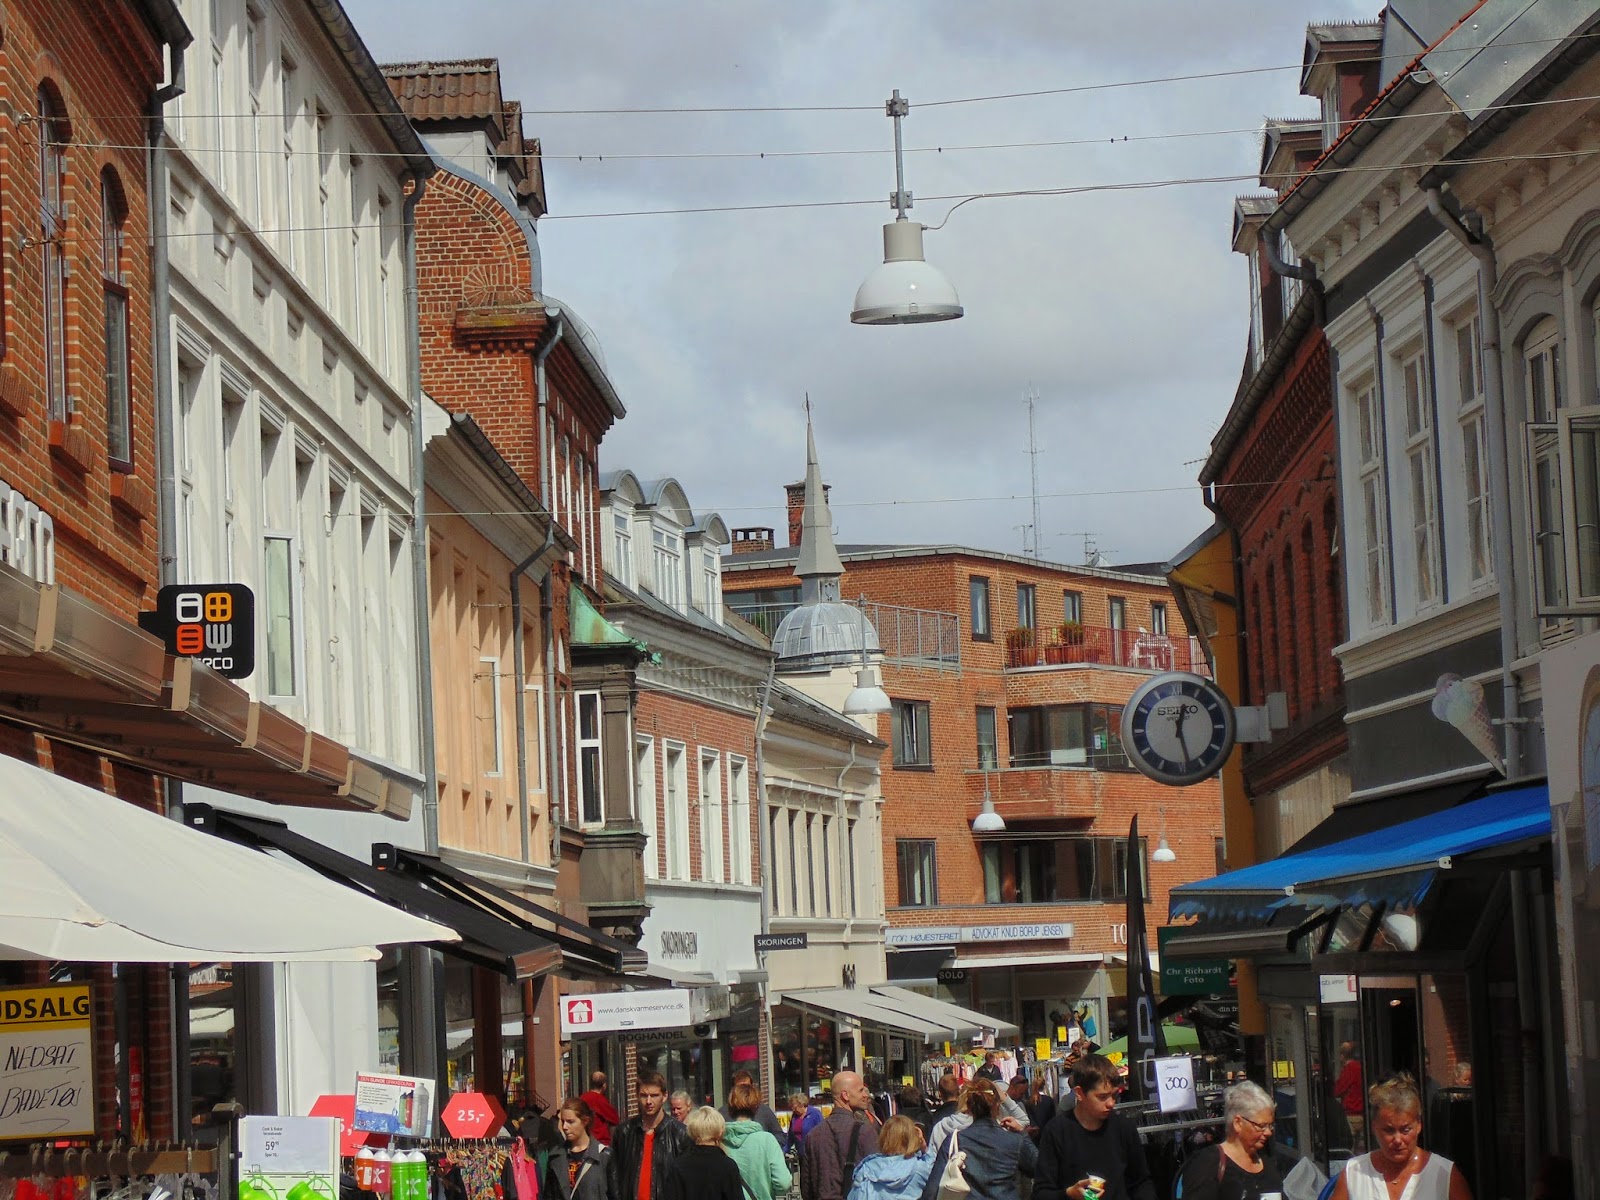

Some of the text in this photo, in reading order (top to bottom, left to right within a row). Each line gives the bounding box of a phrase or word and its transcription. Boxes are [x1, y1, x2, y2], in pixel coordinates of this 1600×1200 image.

[1158, 705, 1198, 716] SEIKO
[971, 927, 1000, 939] ADVOKAT
[1001, 926, 1018, 938] KNUD
[1041, 925, 1064, 936] JENSEN
[757, 937, 804, 947] SKORINGEN
[938, 970, 965, 980] SOLO
[1166, 966, 1223, 976] Chr. Richardt
[1183, 976, 1205, 984] Foto
[0, 995, 90, 1020] DSALG
[597, 1002, 684, 1014] www.danskvarmeservice.dk
[618, 1030, 687, 1042] BOGHANDEL
[5, 1042, 85, 1072] NEDSAT
[457, 1109, 485, 1123] 25,-
